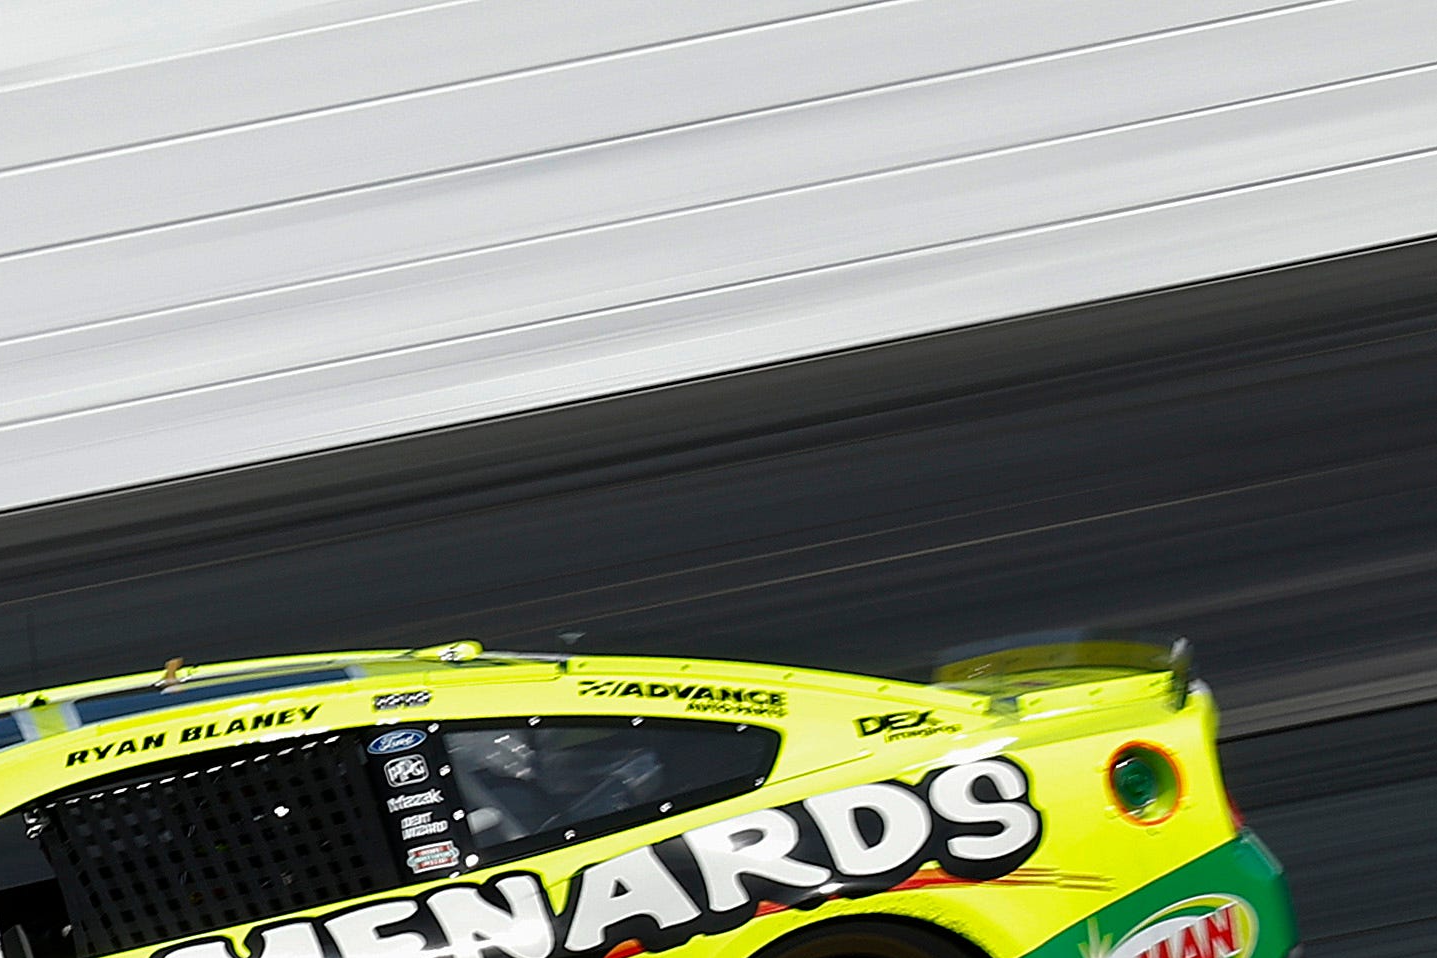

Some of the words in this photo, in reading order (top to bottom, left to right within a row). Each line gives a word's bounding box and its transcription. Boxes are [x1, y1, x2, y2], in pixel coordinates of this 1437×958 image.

[617, 682, 787, 706] ADVANCE
[65, 732, 167, 767] RYAN
[179, 704, 323, 743] BLANEY
[858, 709, 945, 737] DEX
